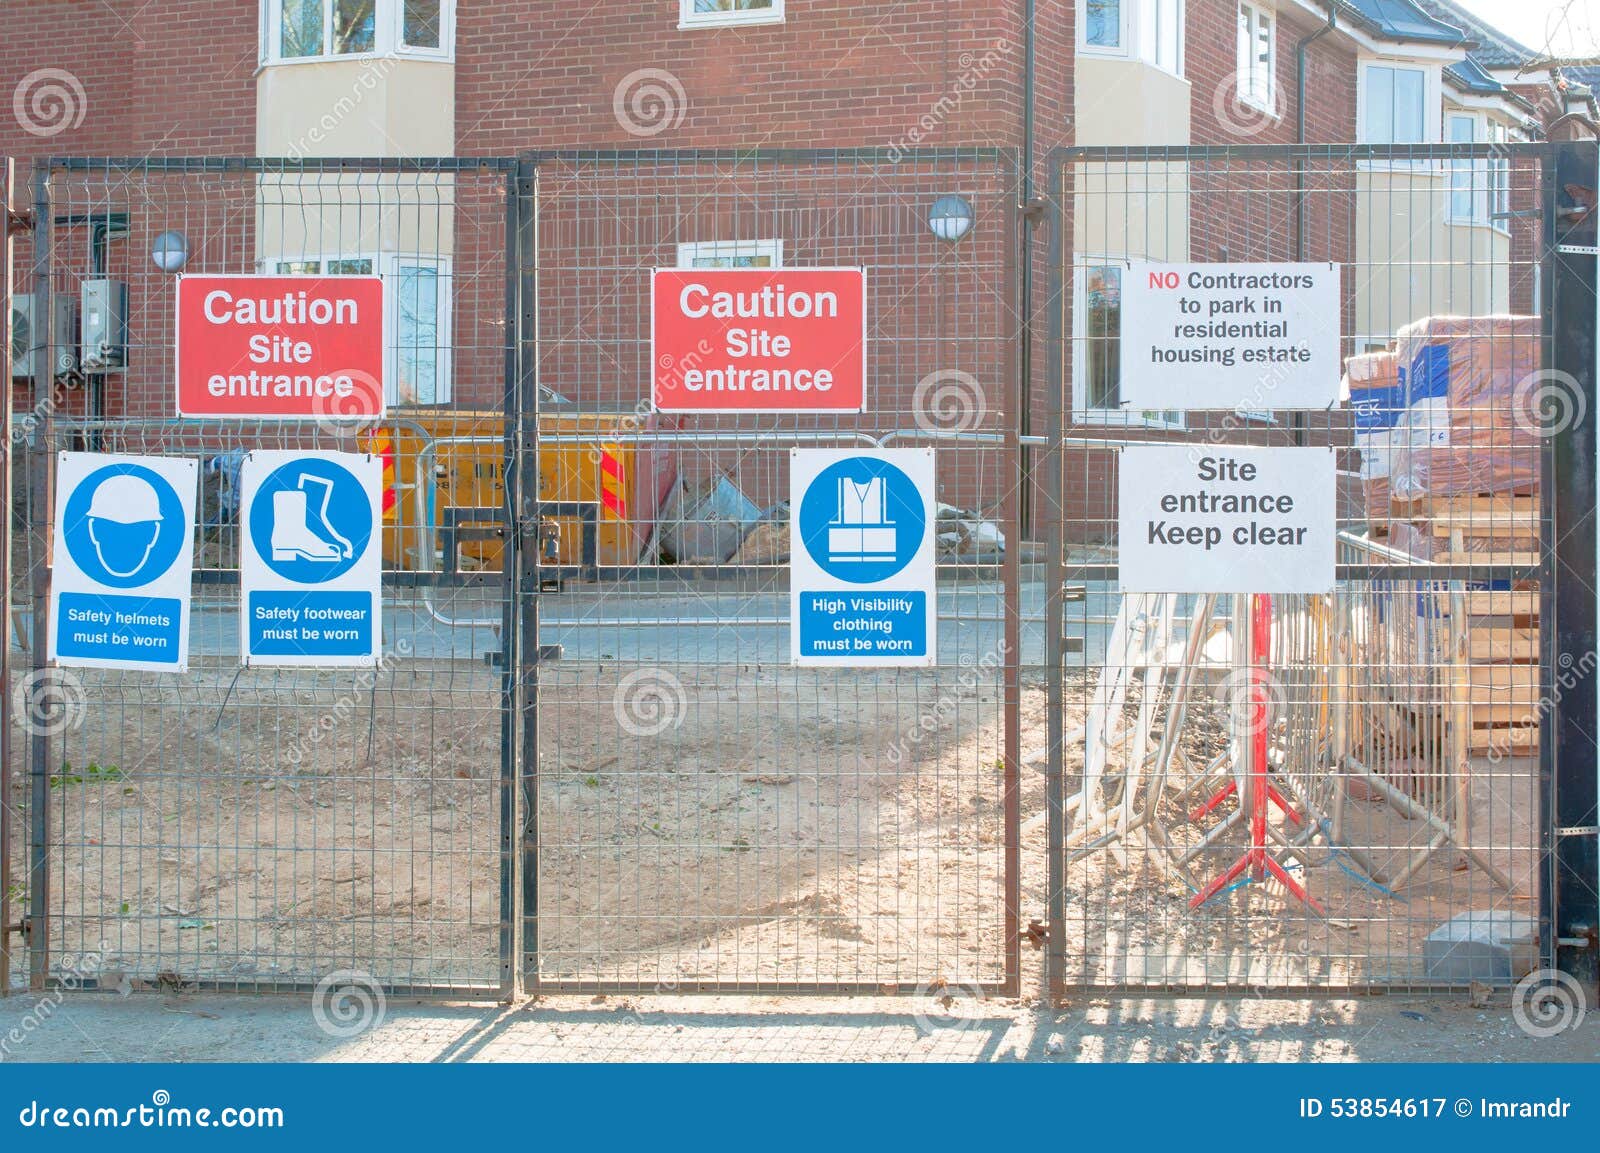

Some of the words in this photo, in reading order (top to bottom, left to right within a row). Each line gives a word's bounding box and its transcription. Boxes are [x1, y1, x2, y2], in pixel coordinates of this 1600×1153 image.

[1149, 271, 1180, 289] NO
[1187, 271, 1314, 289] Contractors
[203, 290, 358, 325] Caution
[679, 283, 838, 319] Caution
[1179, 297, 1201, 313] to
[1208, 296, 1256, 317] park
[1263, 296, 1282, 313] in
[1174, 320, 1288, 338] residential
[248, 334, 313, 364] Site
[726, 328, 791, 358] Site
[1151, 345, 1236, 367] housing
[1242, 345, 1311, 363] estate
[207, 370, 354, 398] entrance
[684, 364, 833, 392] entrance
[1197, 456, 1257, 482] Site
[1160, 490, 1294, 514] entrance
[1148, 521, 1222, 550] Keep
[1232, 520, 1308, 545] clear
[255, 606, 300, 624] Safety
[304, 607, 366, 621] footwear
[812, 598, 846, 614] High
[851, 598, 913, 614] Visibility
[68, 608, 111, 626] Safety
[115, 611, 170, 627] helmets
[833, 618, 892, 634] clothing
[73, 632, 108, 645] must
[111, 633, 129, 645] be
[132, 636, 167, 648] worn
[262, 628, 299, 640] must
[302, 628, 320, 640] be
[323, 630, 359, 640] worn
[813, 638, 850, 650] must
[854, 638, 872, 650] be
[876, 640, 912, 650] worn
